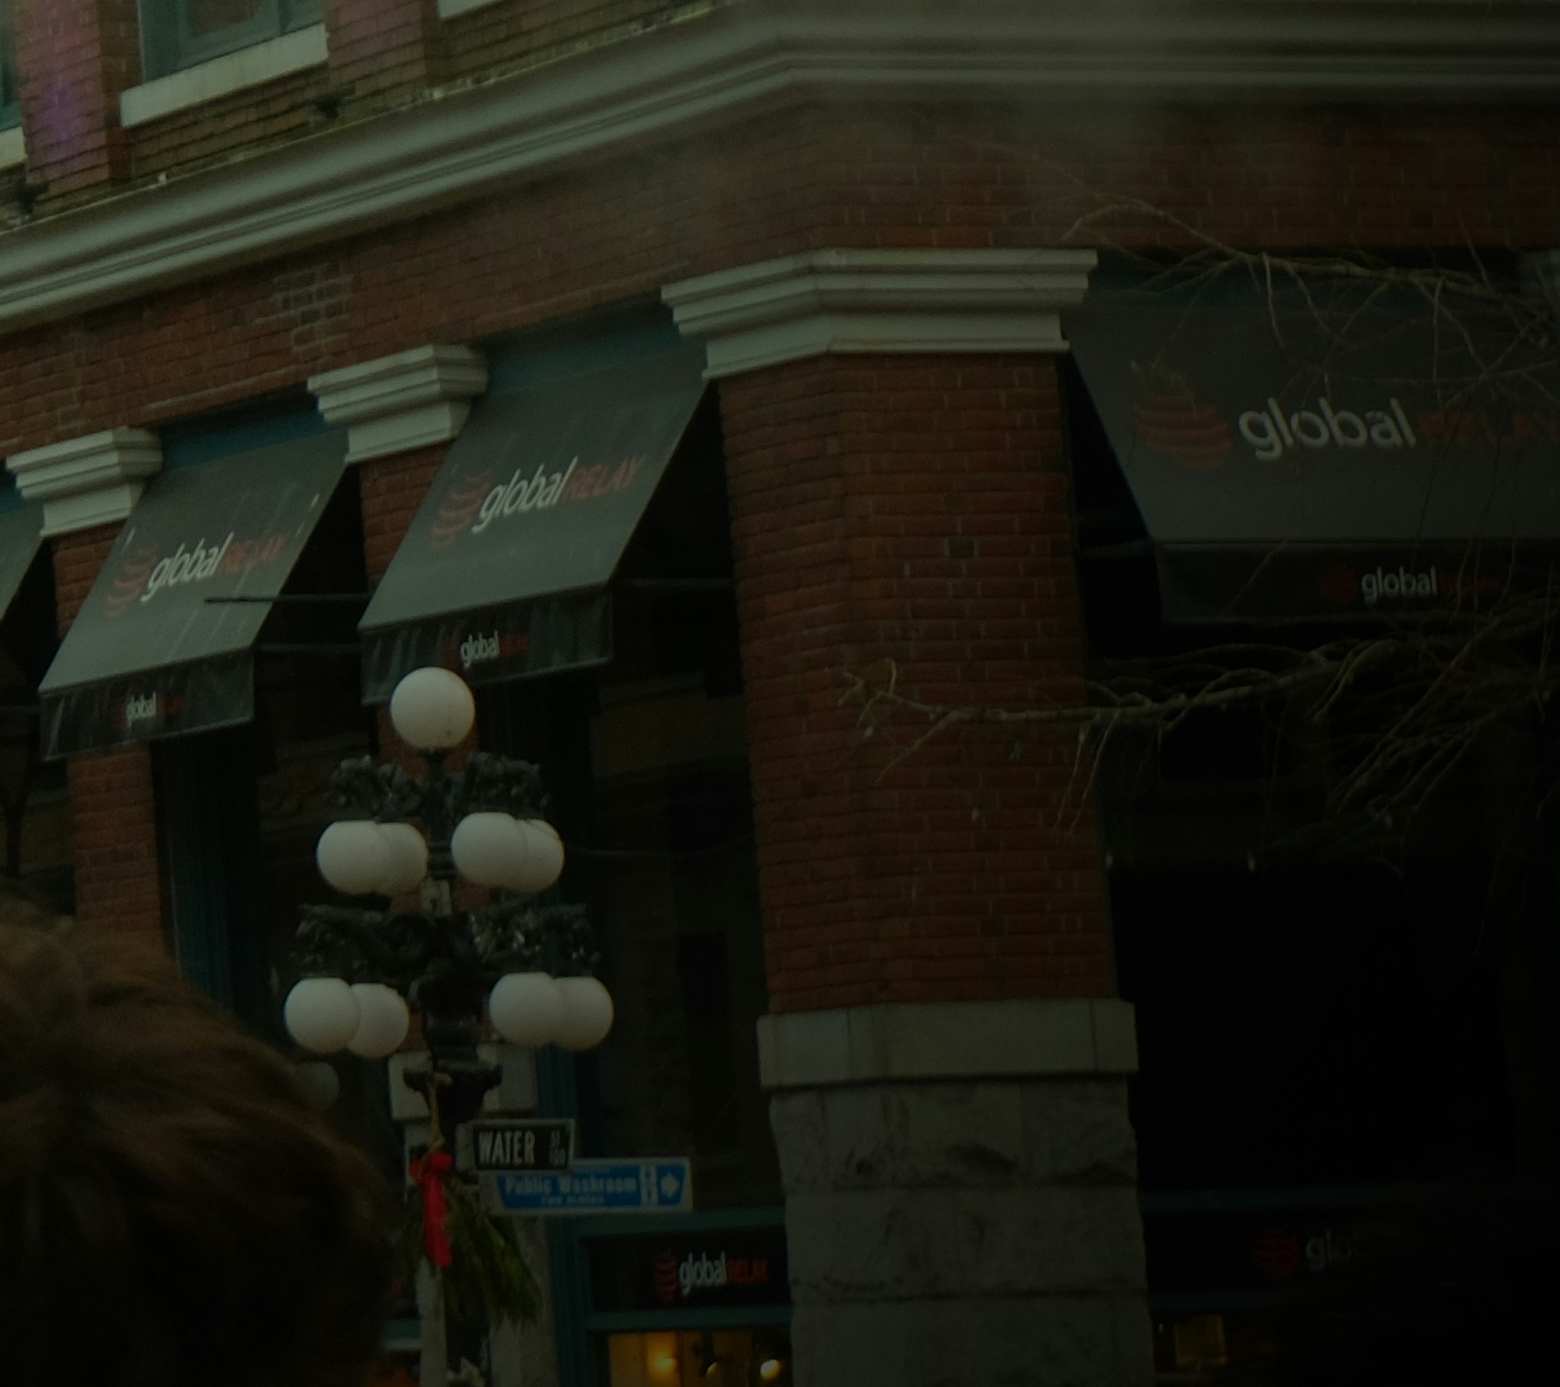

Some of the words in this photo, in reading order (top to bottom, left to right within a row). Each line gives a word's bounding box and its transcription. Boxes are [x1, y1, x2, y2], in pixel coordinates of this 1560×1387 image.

[1238, 396, 1417, 461] global
[471, 455, 579, 534] global
[140, 530, 235, 604] global
[1360, 564, 1437, 606] global
[460, 629, 500, 671] global
[478, 1130, 536, 1164] WATER
[559, 1176, 637, 1195] Washroom
[678, 1249, 727, 1298] global
